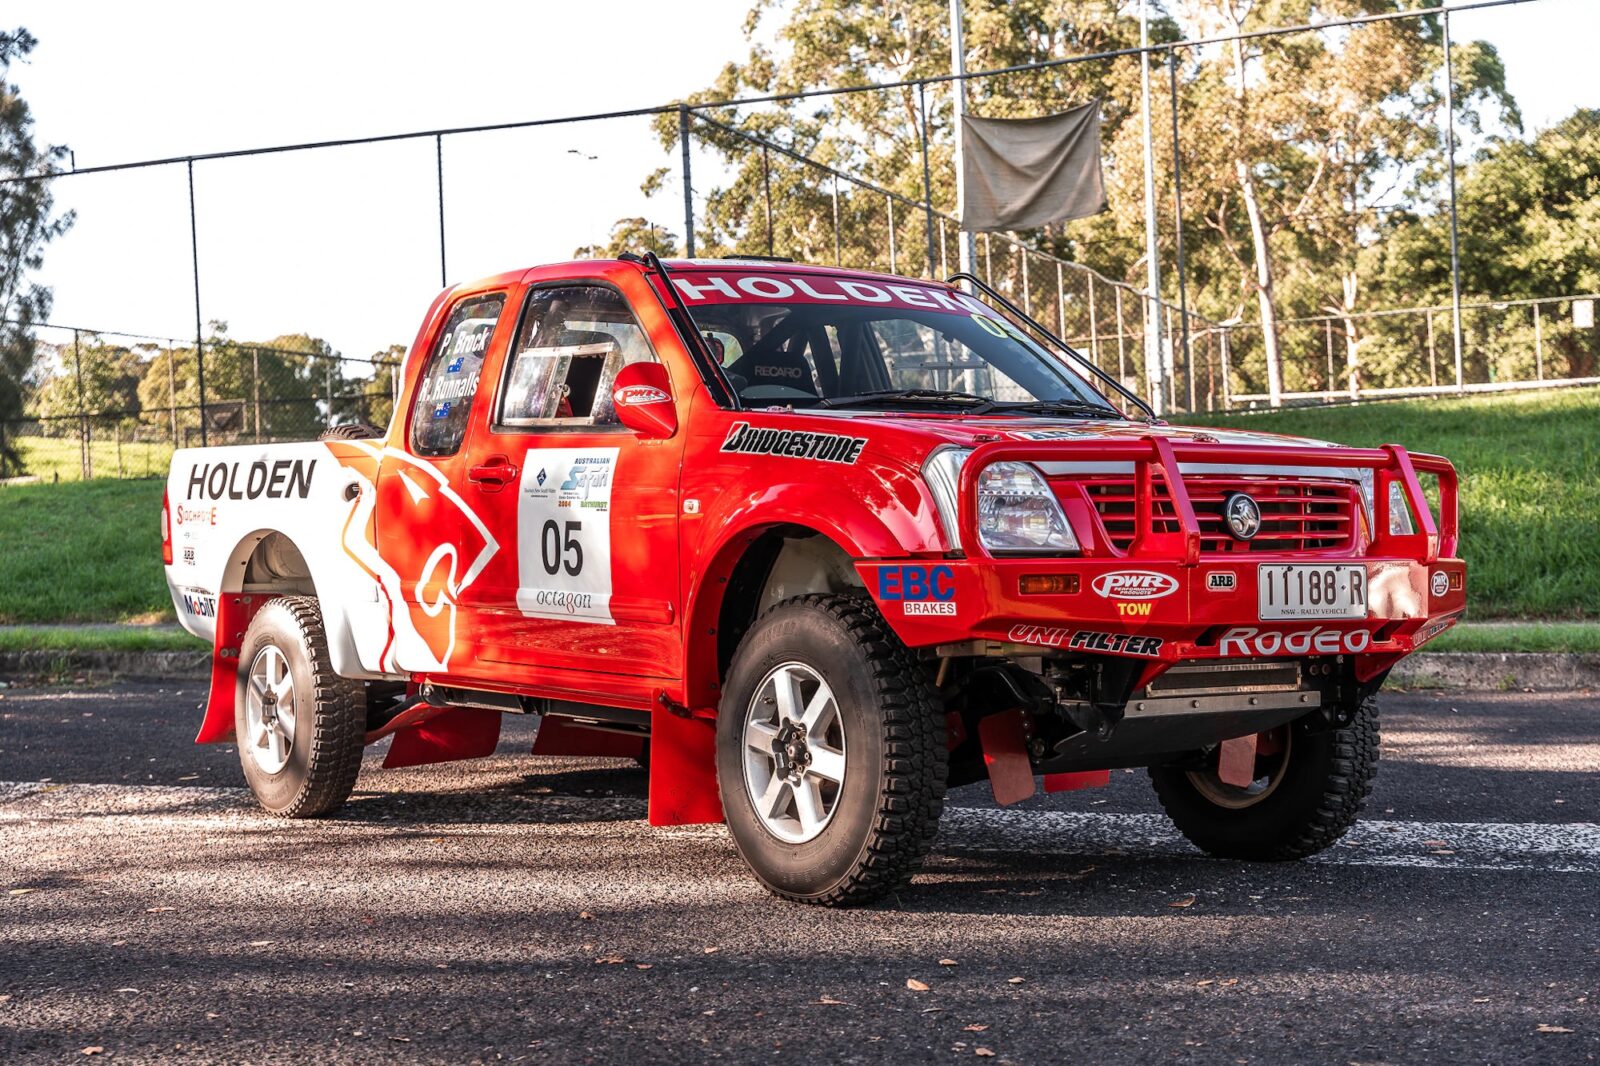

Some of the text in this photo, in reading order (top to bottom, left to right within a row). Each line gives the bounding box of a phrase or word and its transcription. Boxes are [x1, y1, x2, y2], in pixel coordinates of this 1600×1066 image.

[671, 276, 985, 316] HOLDEN
[453, 327, 490, 355] Brock
[432, 371, 480, 400] Runnalls
[754, 365, 802, 378] RECARO
[721, 422, 868, 464] BRIDGESTONE
[187, 459, 317, 500] HOLDEN
[560, 466, 610, 500] Safari
[541, 519, 583, 576] 05
[878, 565, 955, 602] EBC
[1102, 574, 1172, 598] PWR
[1210, 575, 1234, 587] ARB
[1267, 570, 1336, 605] 11188
[536, 590, 592, 614] octagon
[904, 603, 955, 614] BRAKES
[1117, 603, 1152, 615] TOW
[1008, 624, 1164, 656] UNI FILTER
